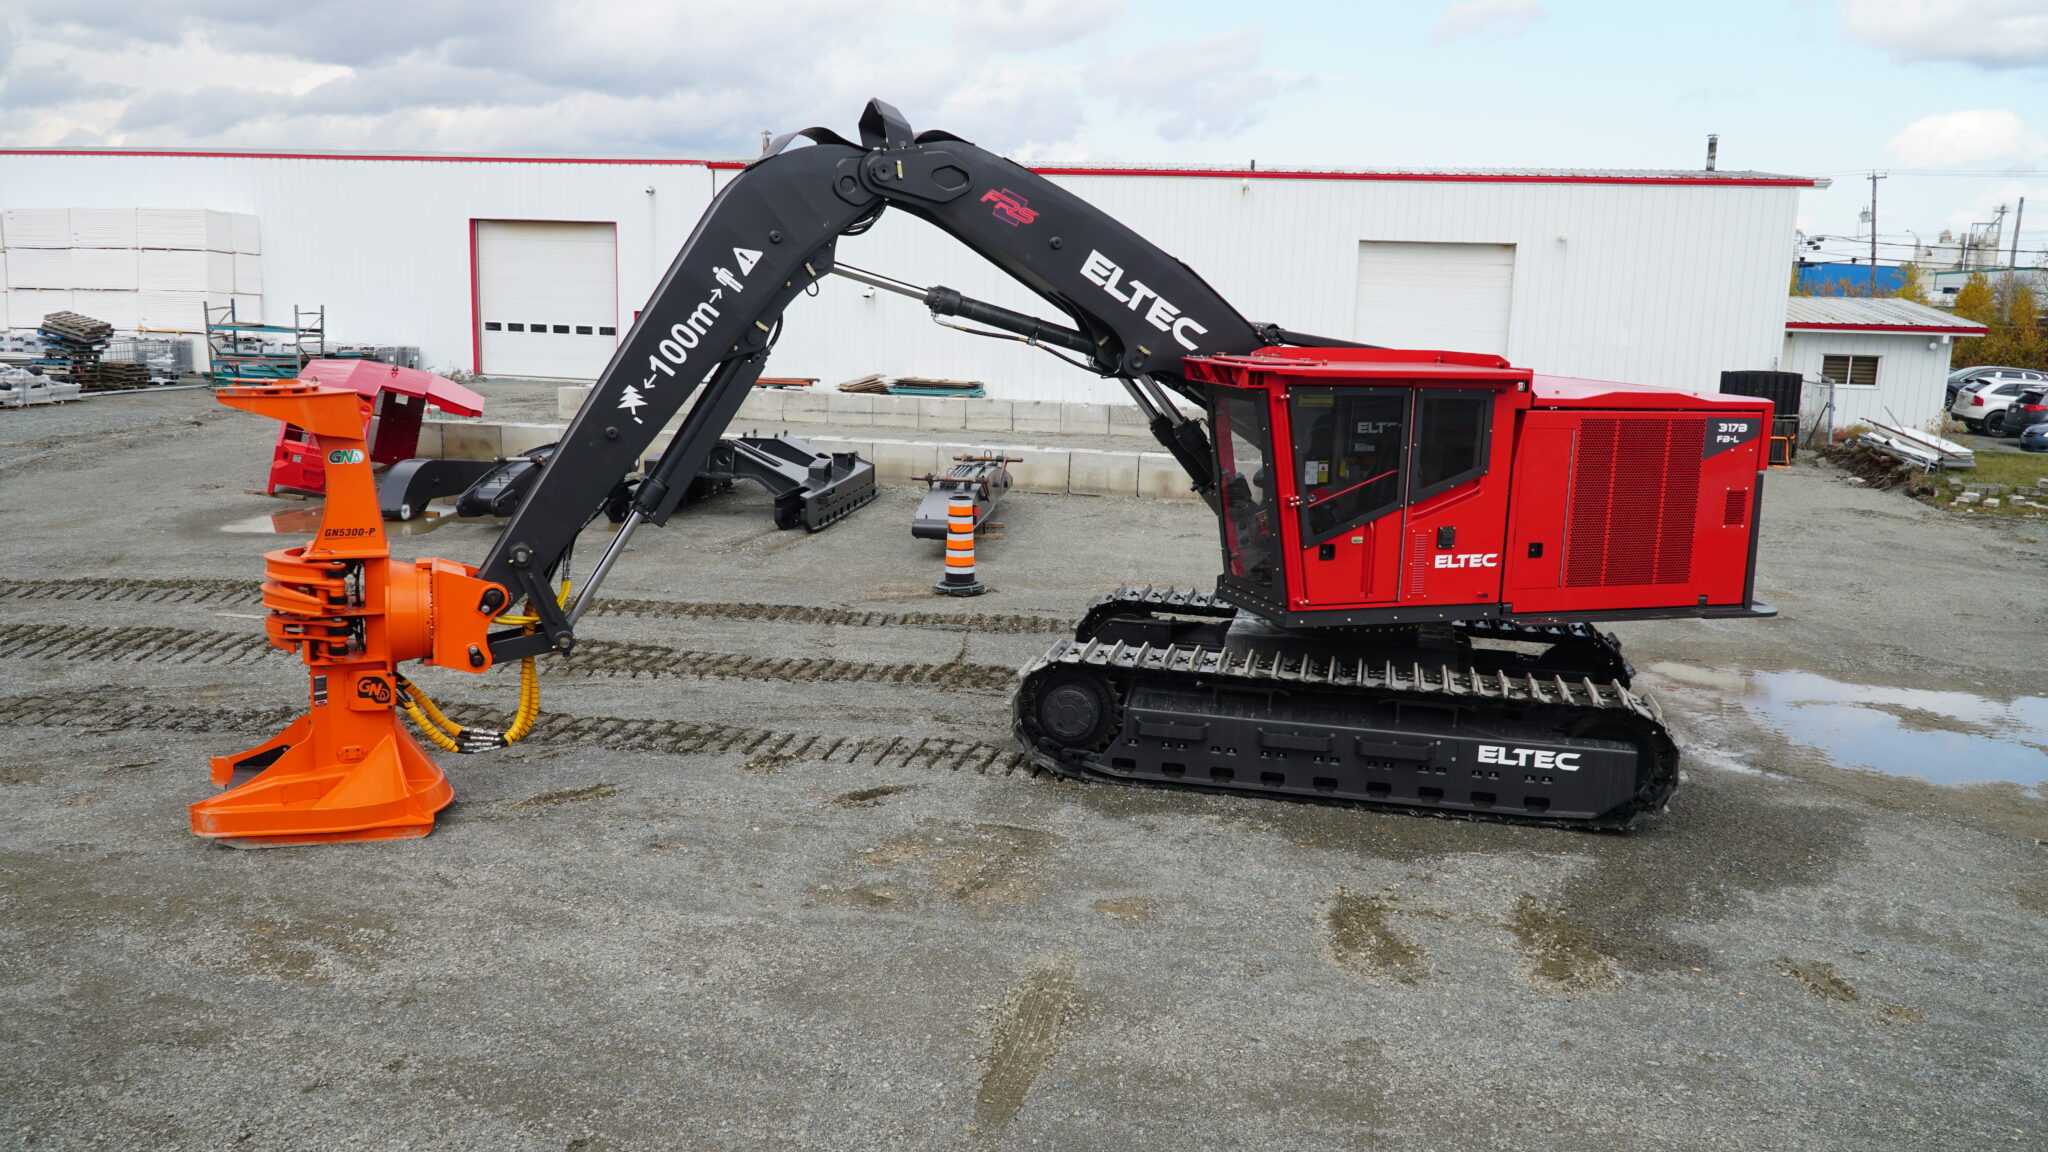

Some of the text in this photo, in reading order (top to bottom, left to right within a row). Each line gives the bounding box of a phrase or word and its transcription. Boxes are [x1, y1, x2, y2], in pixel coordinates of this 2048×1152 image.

[980, 188, 1040, 225] FRS
[1079, 248, 1209, 351] ELTEC
[648, 302, 720, 377] 100m
[1356, 421, 1402, 434] ELT
[1718, 423, 1748, 433] 317B
[1716, 435, 1740, 443] FB-L
[325, 528, 376, 537] GN5300-P
[1434, 553, 1499, 569] ELTEC
[1477, 744, 1581, 772] ELTEC
